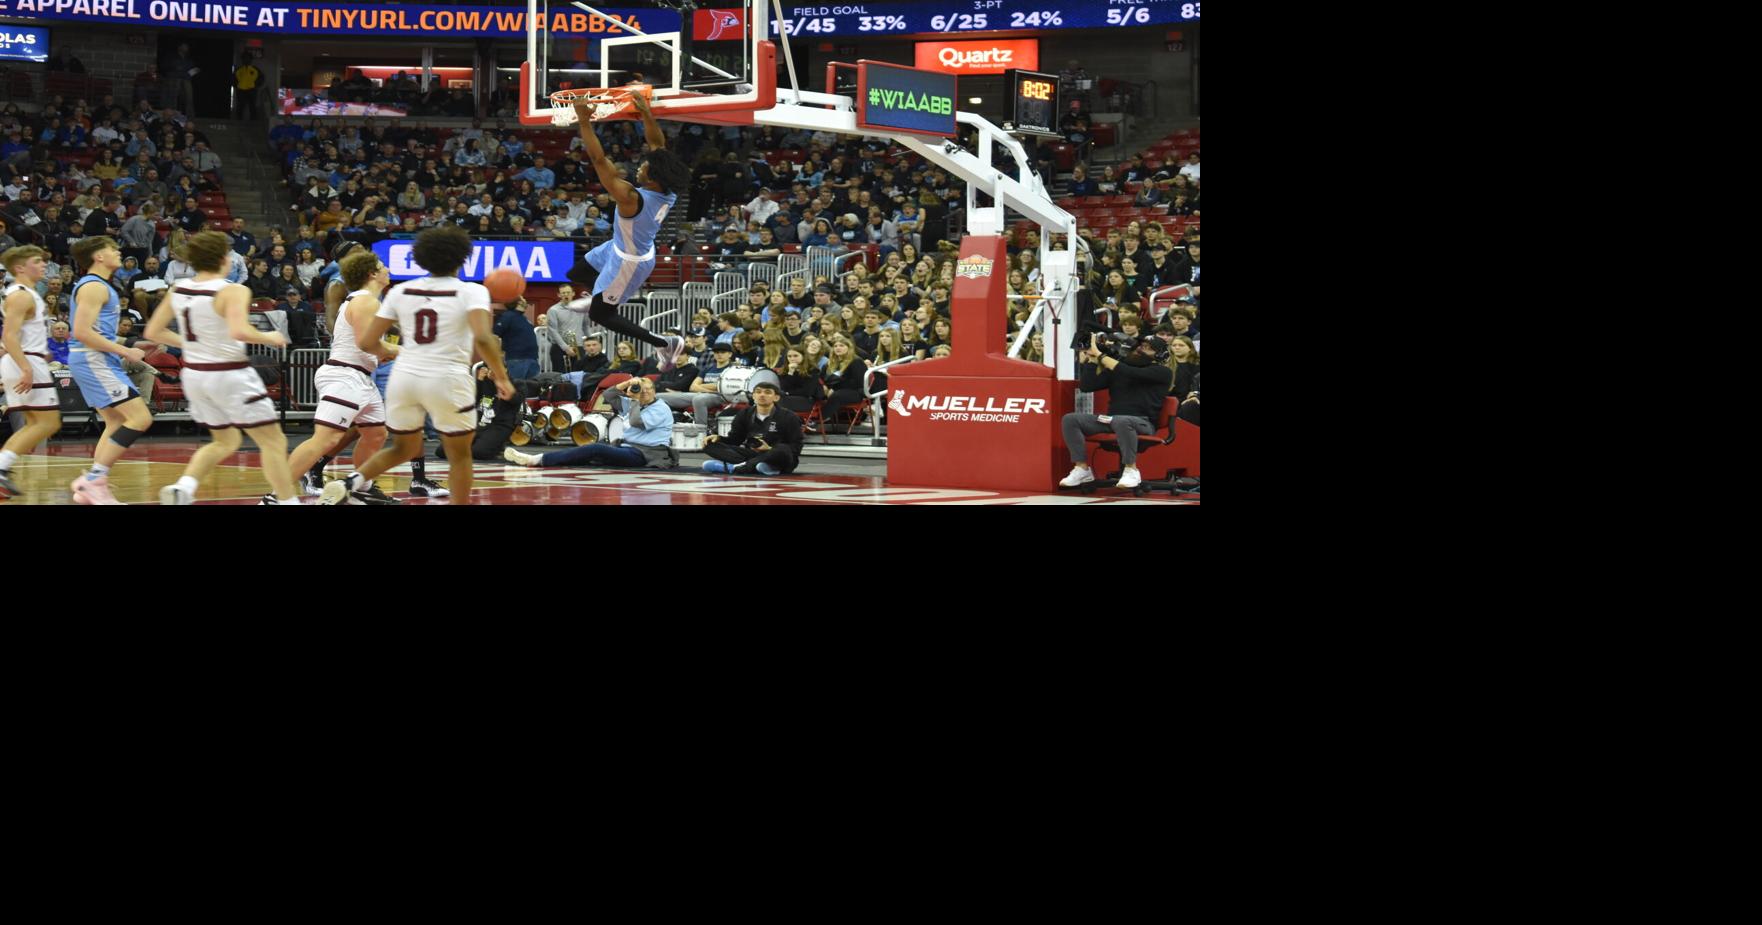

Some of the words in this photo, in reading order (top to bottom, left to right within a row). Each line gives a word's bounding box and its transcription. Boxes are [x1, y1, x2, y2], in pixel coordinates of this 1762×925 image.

[17, 0, 141, 18] APPAREL
[149, 1, 249, 26] ONLINE
[256, 7, 289, 27] AT
[793, 7, 829, 16] FIELD
[832, 6, 868, 15] GOAL
[973, 0, 1003, 10] 3-PT
[770, 17, 836, 36] 15/45
[858, 15, 906, 31] 33%
[930, 13, 988, 32] 6/25
[1010, 11, 1063, 27] 24%
[1106, 6, 1150, 26] 5/6
[938, 47, 1013, 68] Quartz
[1023, 80, 1051, 100] 8:02
[868, 88, 952, 115] #WIAABB
[958, 263, 991, 273] STATE
[183, 308, 198, 342] 1
[414, 308, 438, 345] 0
[907, 395, 1046, 414] MUELLER
[929, 412, 969, 421] SPORTS
[971, 413, 1020, 423] MEDICINE
